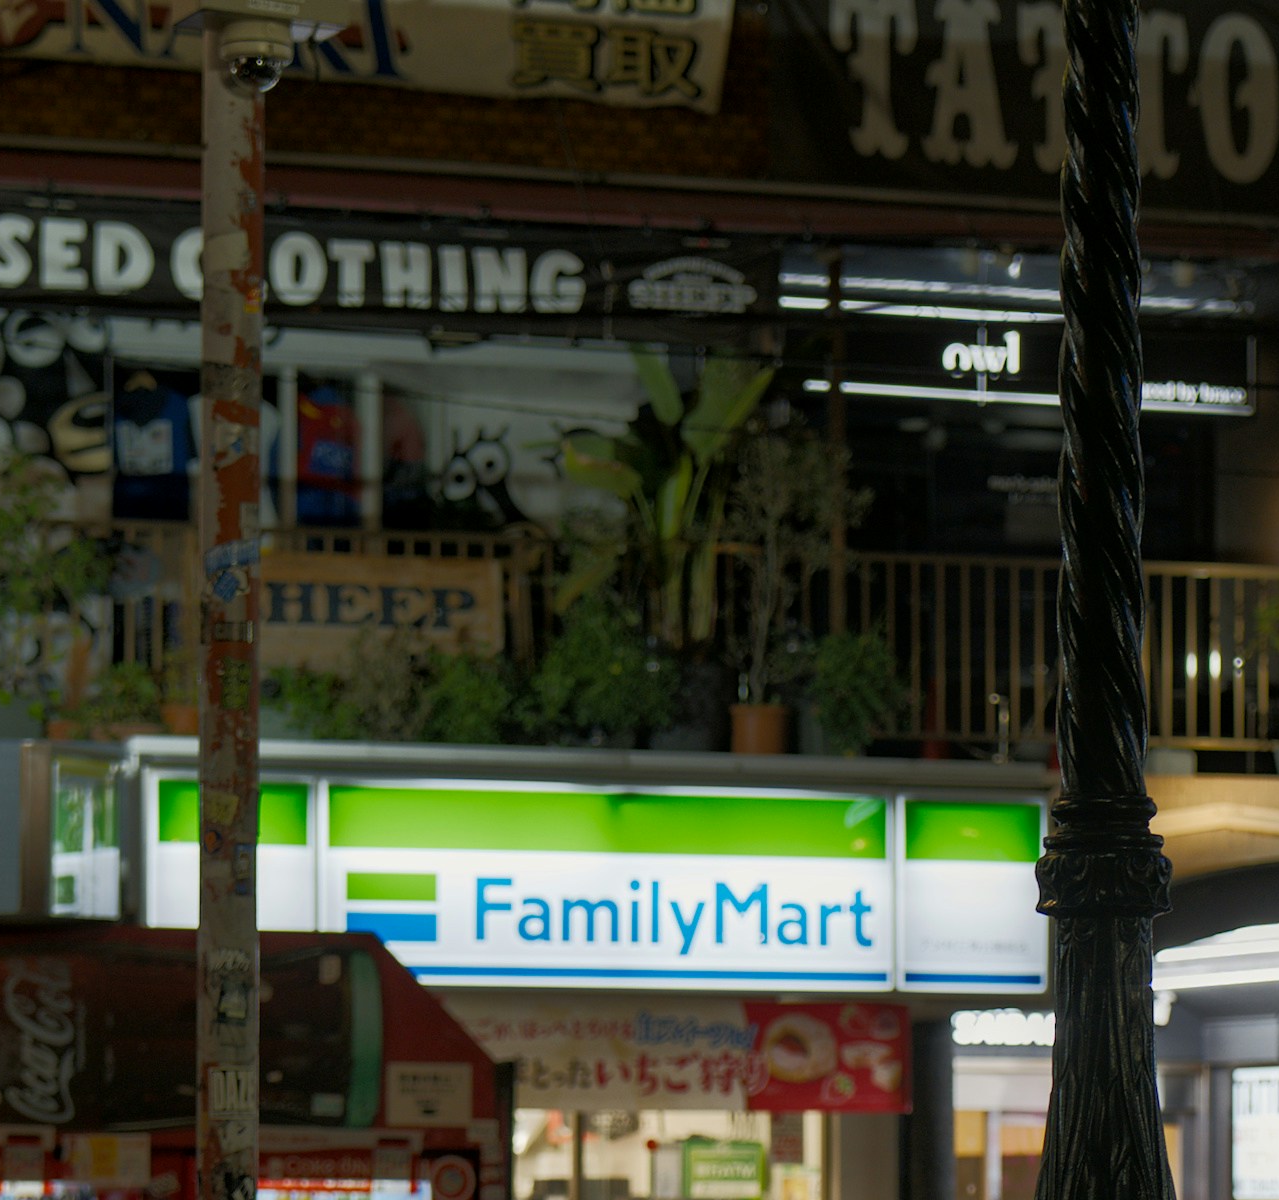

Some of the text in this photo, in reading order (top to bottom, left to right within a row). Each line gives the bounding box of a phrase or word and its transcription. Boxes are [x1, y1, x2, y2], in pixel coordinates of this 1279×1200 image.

[513, 20, 701, 97] 買取
[170, 225, 586, 314] COTHING
[942, 330, 1021, 378] owl
[267, 582, 475, 629] HEEP
[475, 877, 873, 956] FamilyMart
